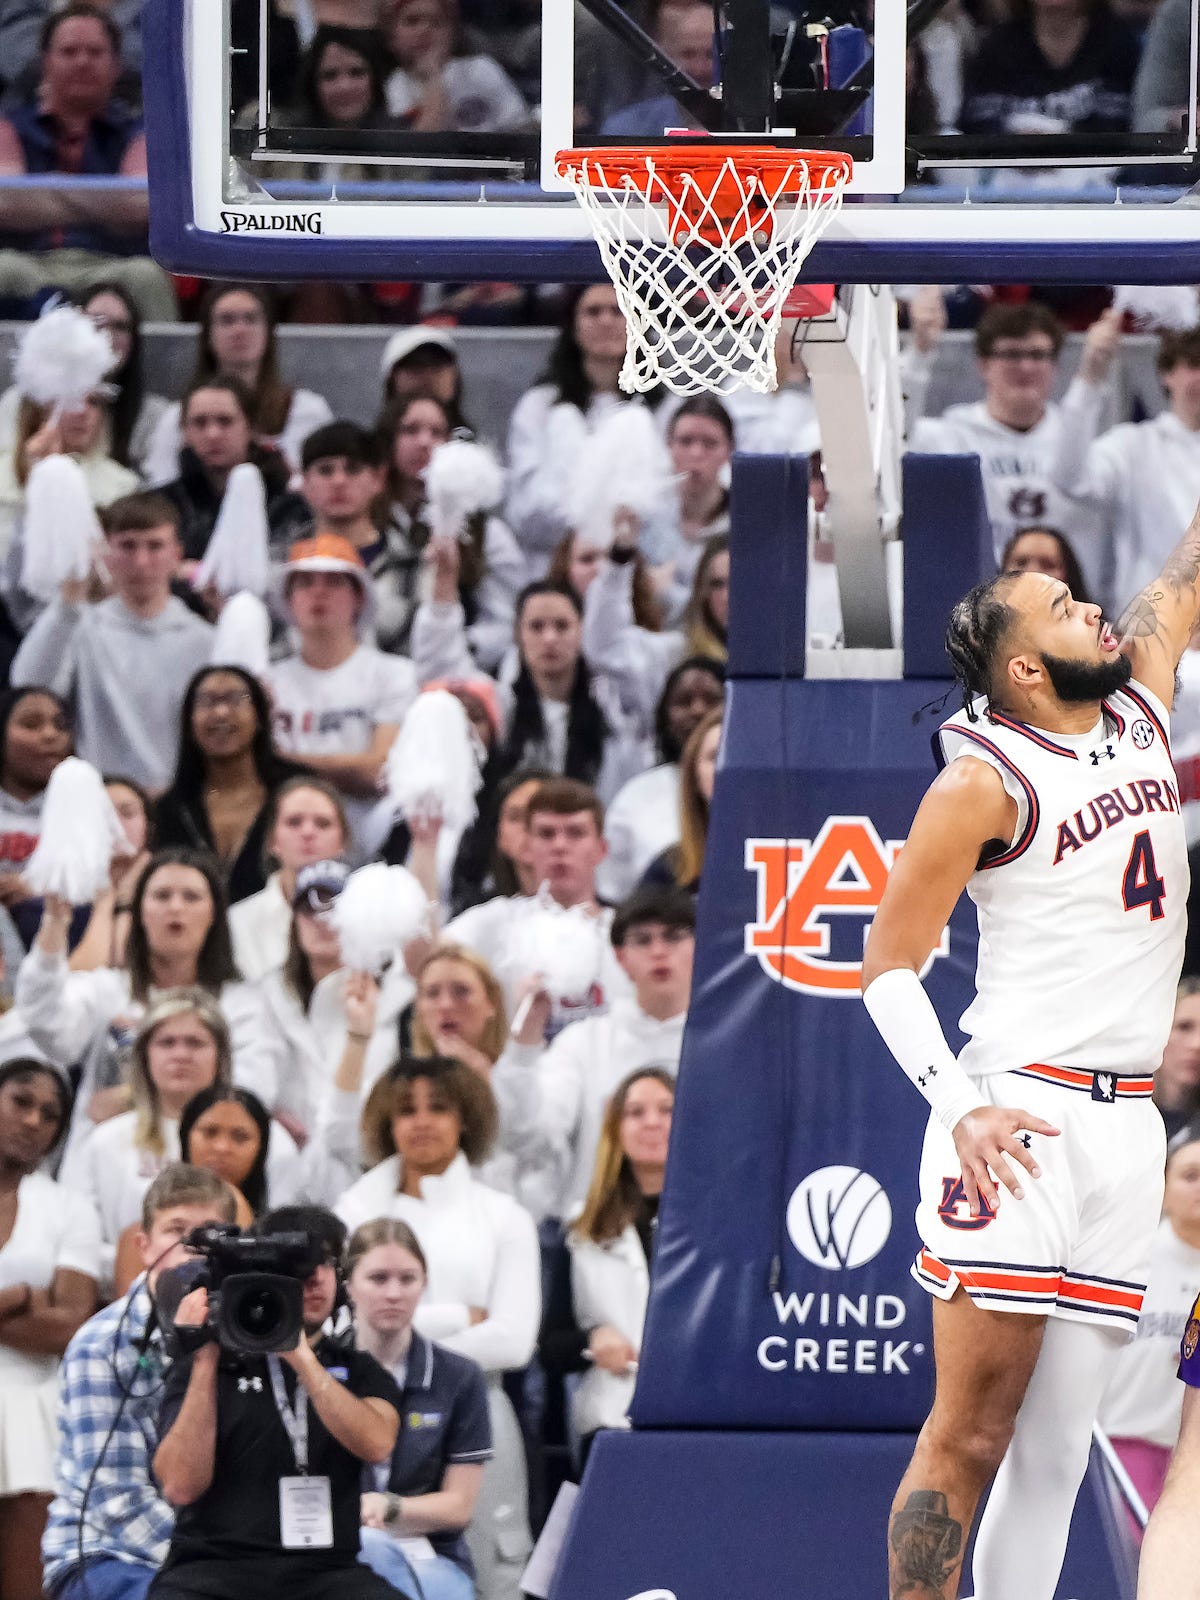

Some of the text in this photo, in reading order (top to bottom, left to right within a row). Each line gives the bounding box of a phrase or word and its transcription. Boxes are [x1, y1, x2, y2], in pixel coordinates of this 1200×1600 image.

[220, 211, 321, 235] SPALDING
[1053, 779, 1181, 866] AUBURN
[1121, 829, 1166, 922] 4
[772, 1292, 907, 1329] WIND
